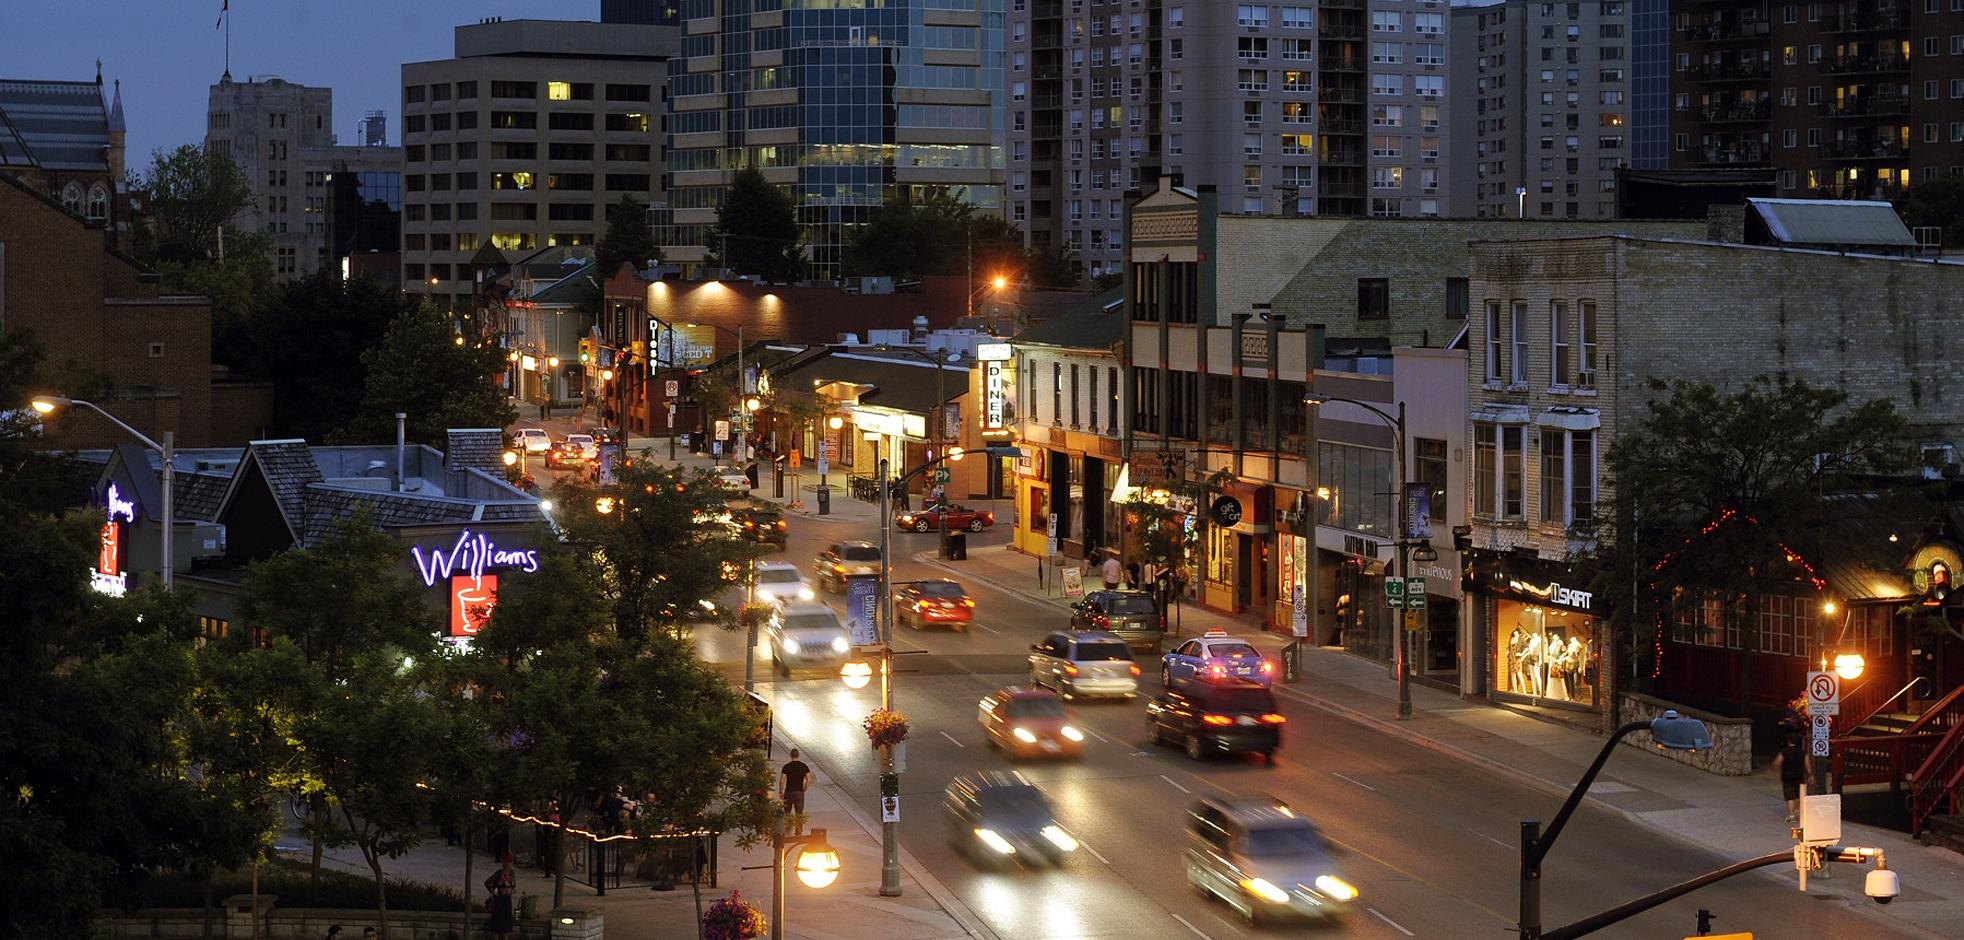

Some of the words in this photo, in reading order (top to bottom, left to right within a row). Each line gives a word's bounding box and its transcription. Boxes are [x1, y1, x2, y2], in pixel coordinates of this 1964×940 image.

[989, 366, 1000, 423] DINER
[936, 471, 943, 482] P
[411, 529, 537, 586] Williams
